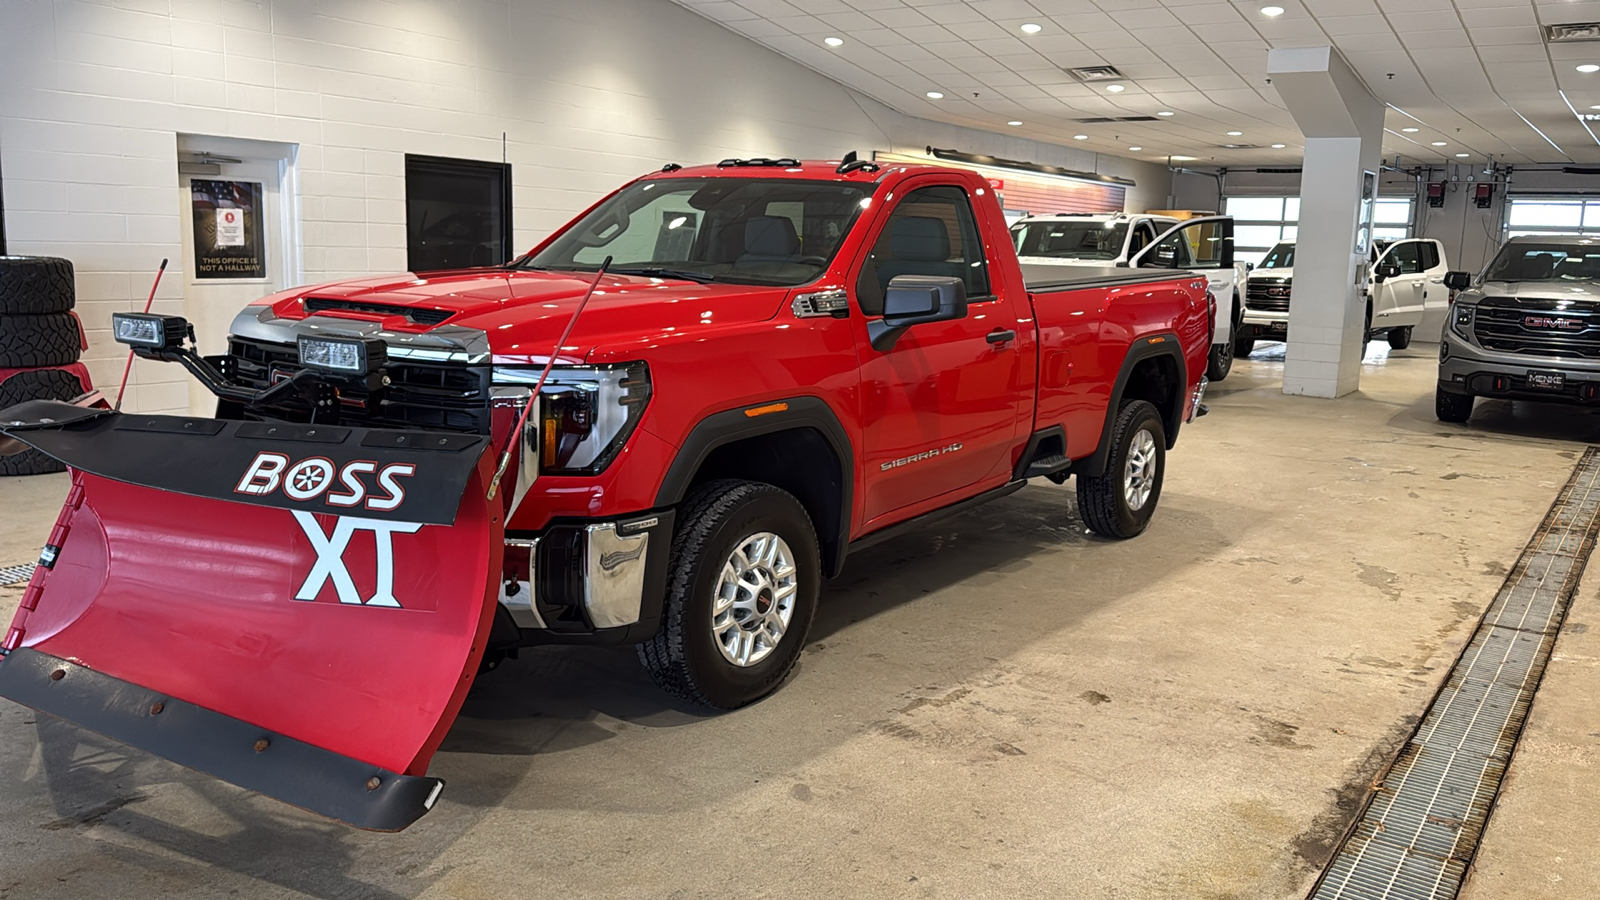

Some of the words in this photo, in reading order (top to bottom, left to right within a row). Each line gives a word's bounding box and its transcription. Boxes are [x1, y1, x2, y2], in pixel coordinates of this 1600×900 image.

[1268, 287, 1291, 295] GM
[1525, 316, 1583, 329] GMC
[1529, 374, 1562, 384] MENKE
[881, 448, 939, 471] SIERRA
[942, 442, 963, 454] HD
[233, 451, 417, 511] BOSS
[290, 509, 425, 609] XT
